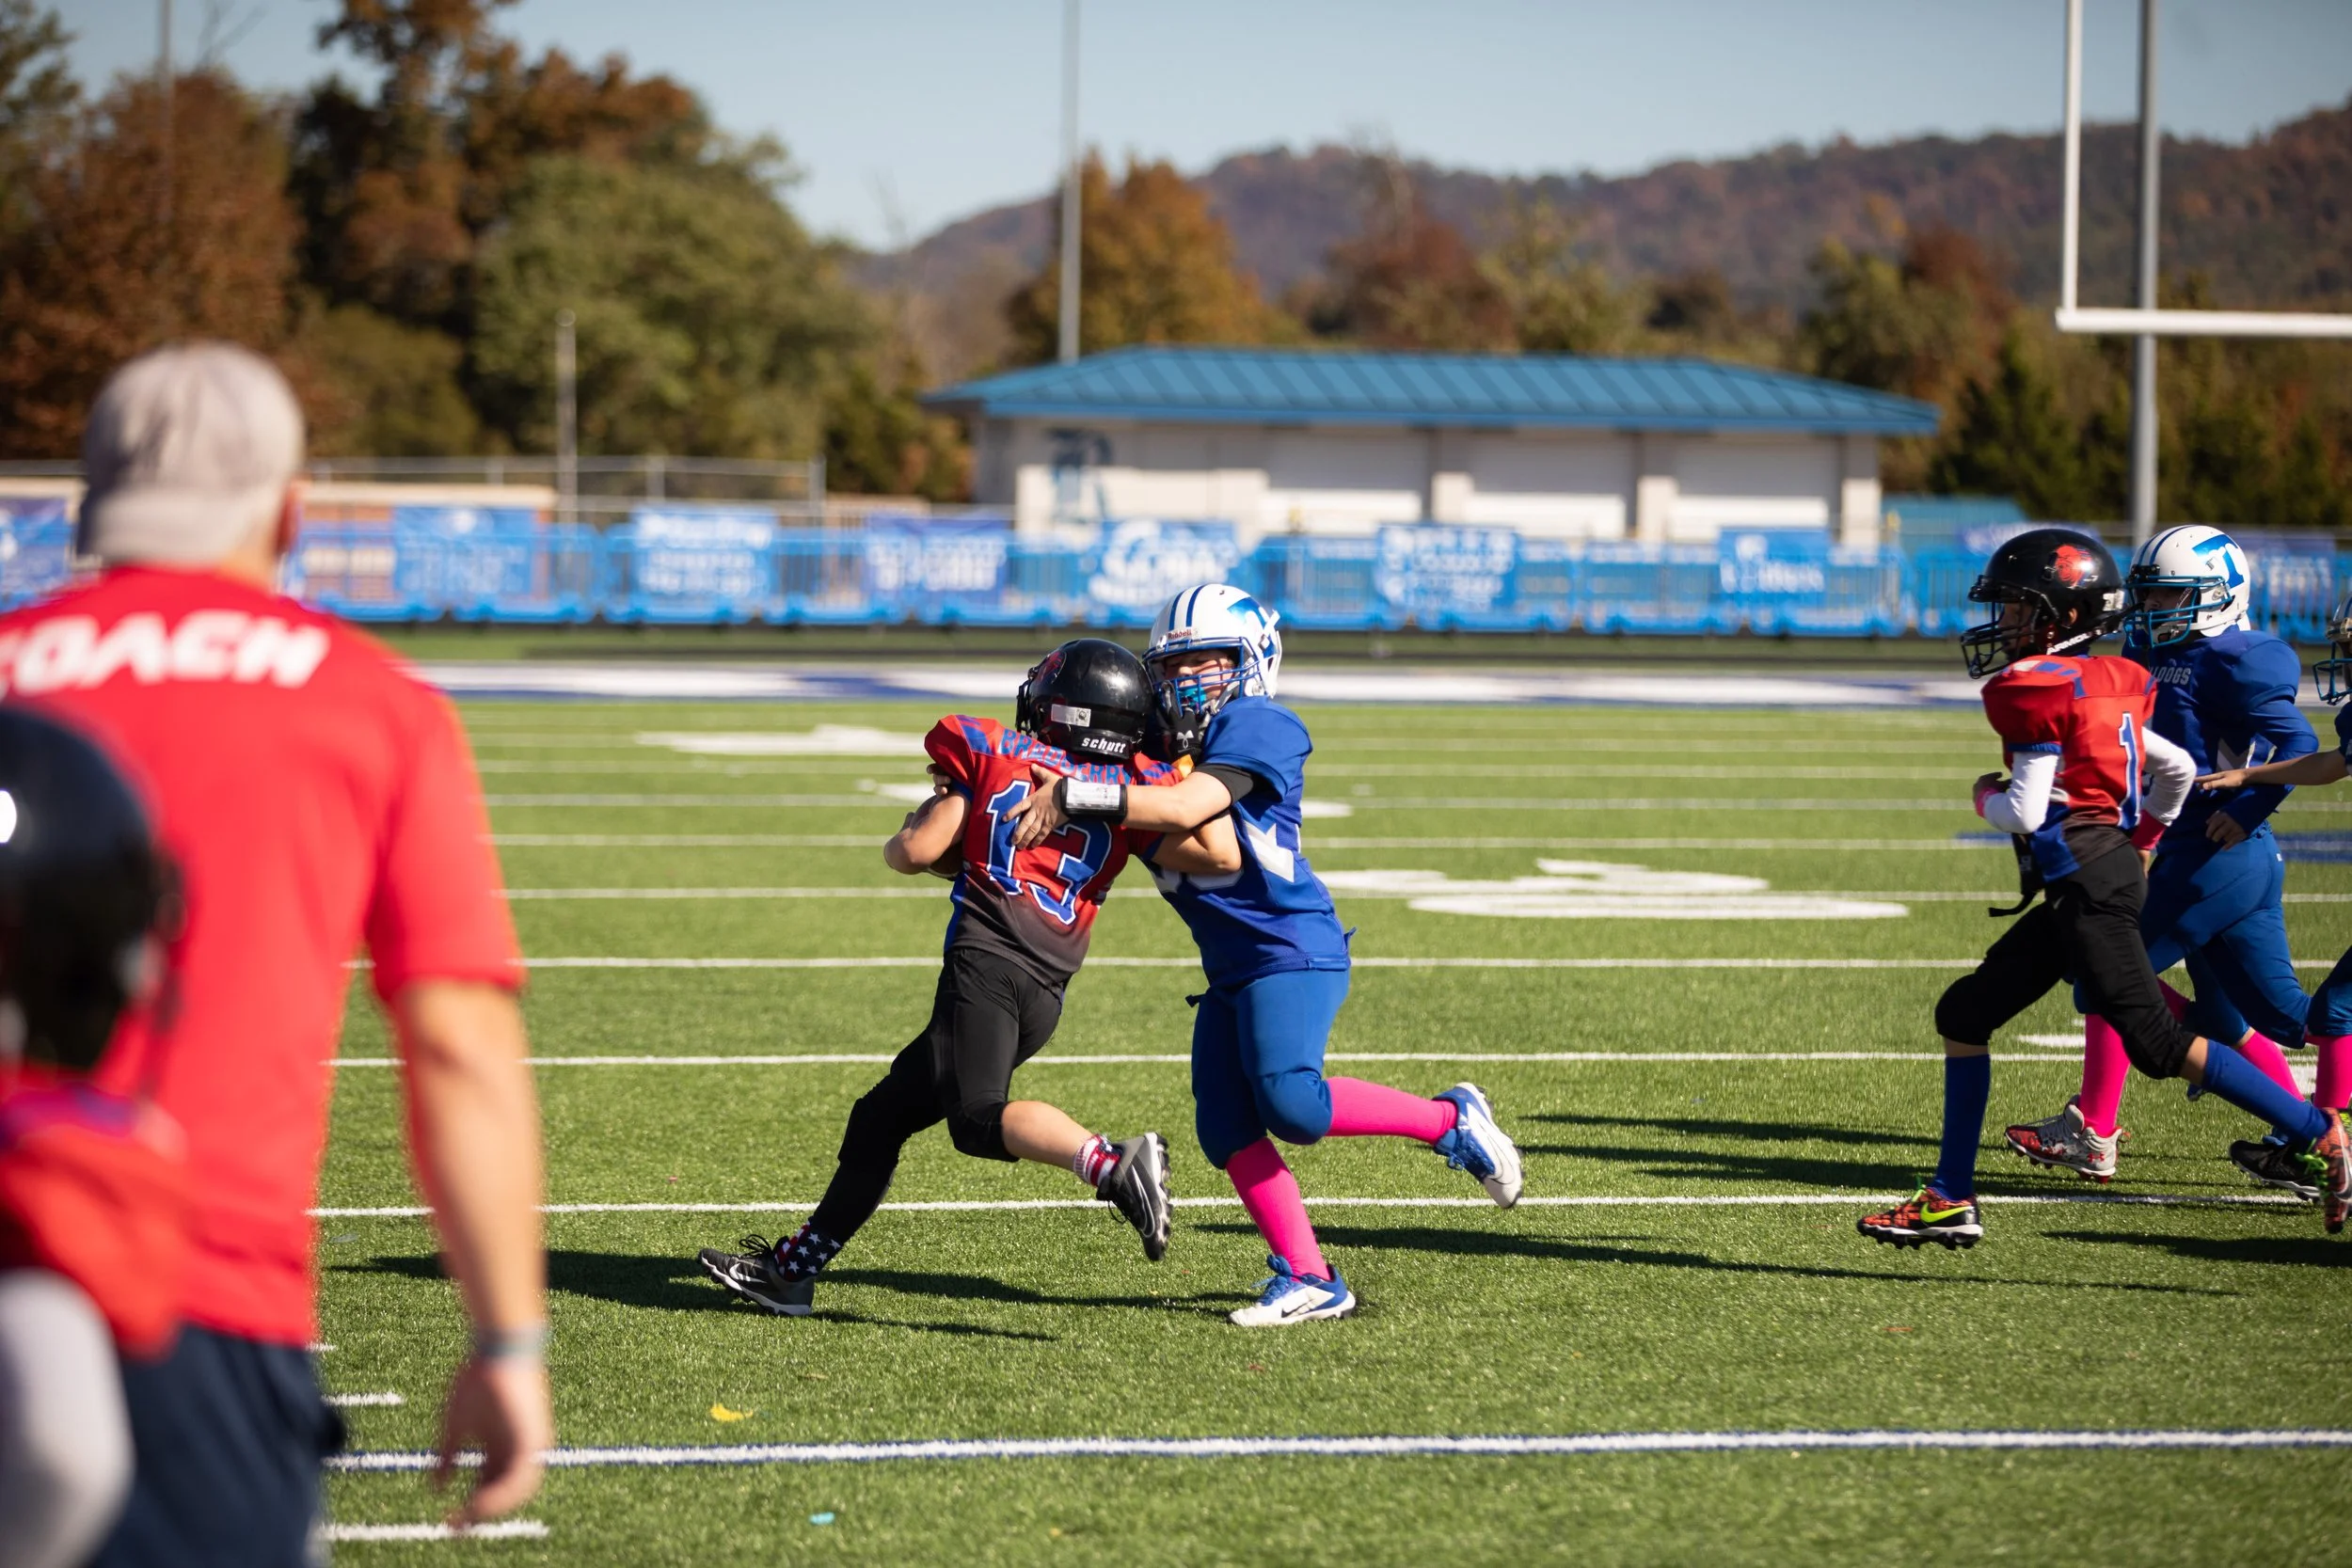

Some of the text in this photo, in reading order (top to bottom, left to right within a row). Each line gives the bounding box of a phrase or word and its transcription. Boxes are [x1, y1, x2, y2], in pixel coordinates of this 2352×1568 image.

[1081, 736, 1126, 753] schutt
[2117, 711, 2140, 829] 1
[986, 780, 1112, 926] 13
